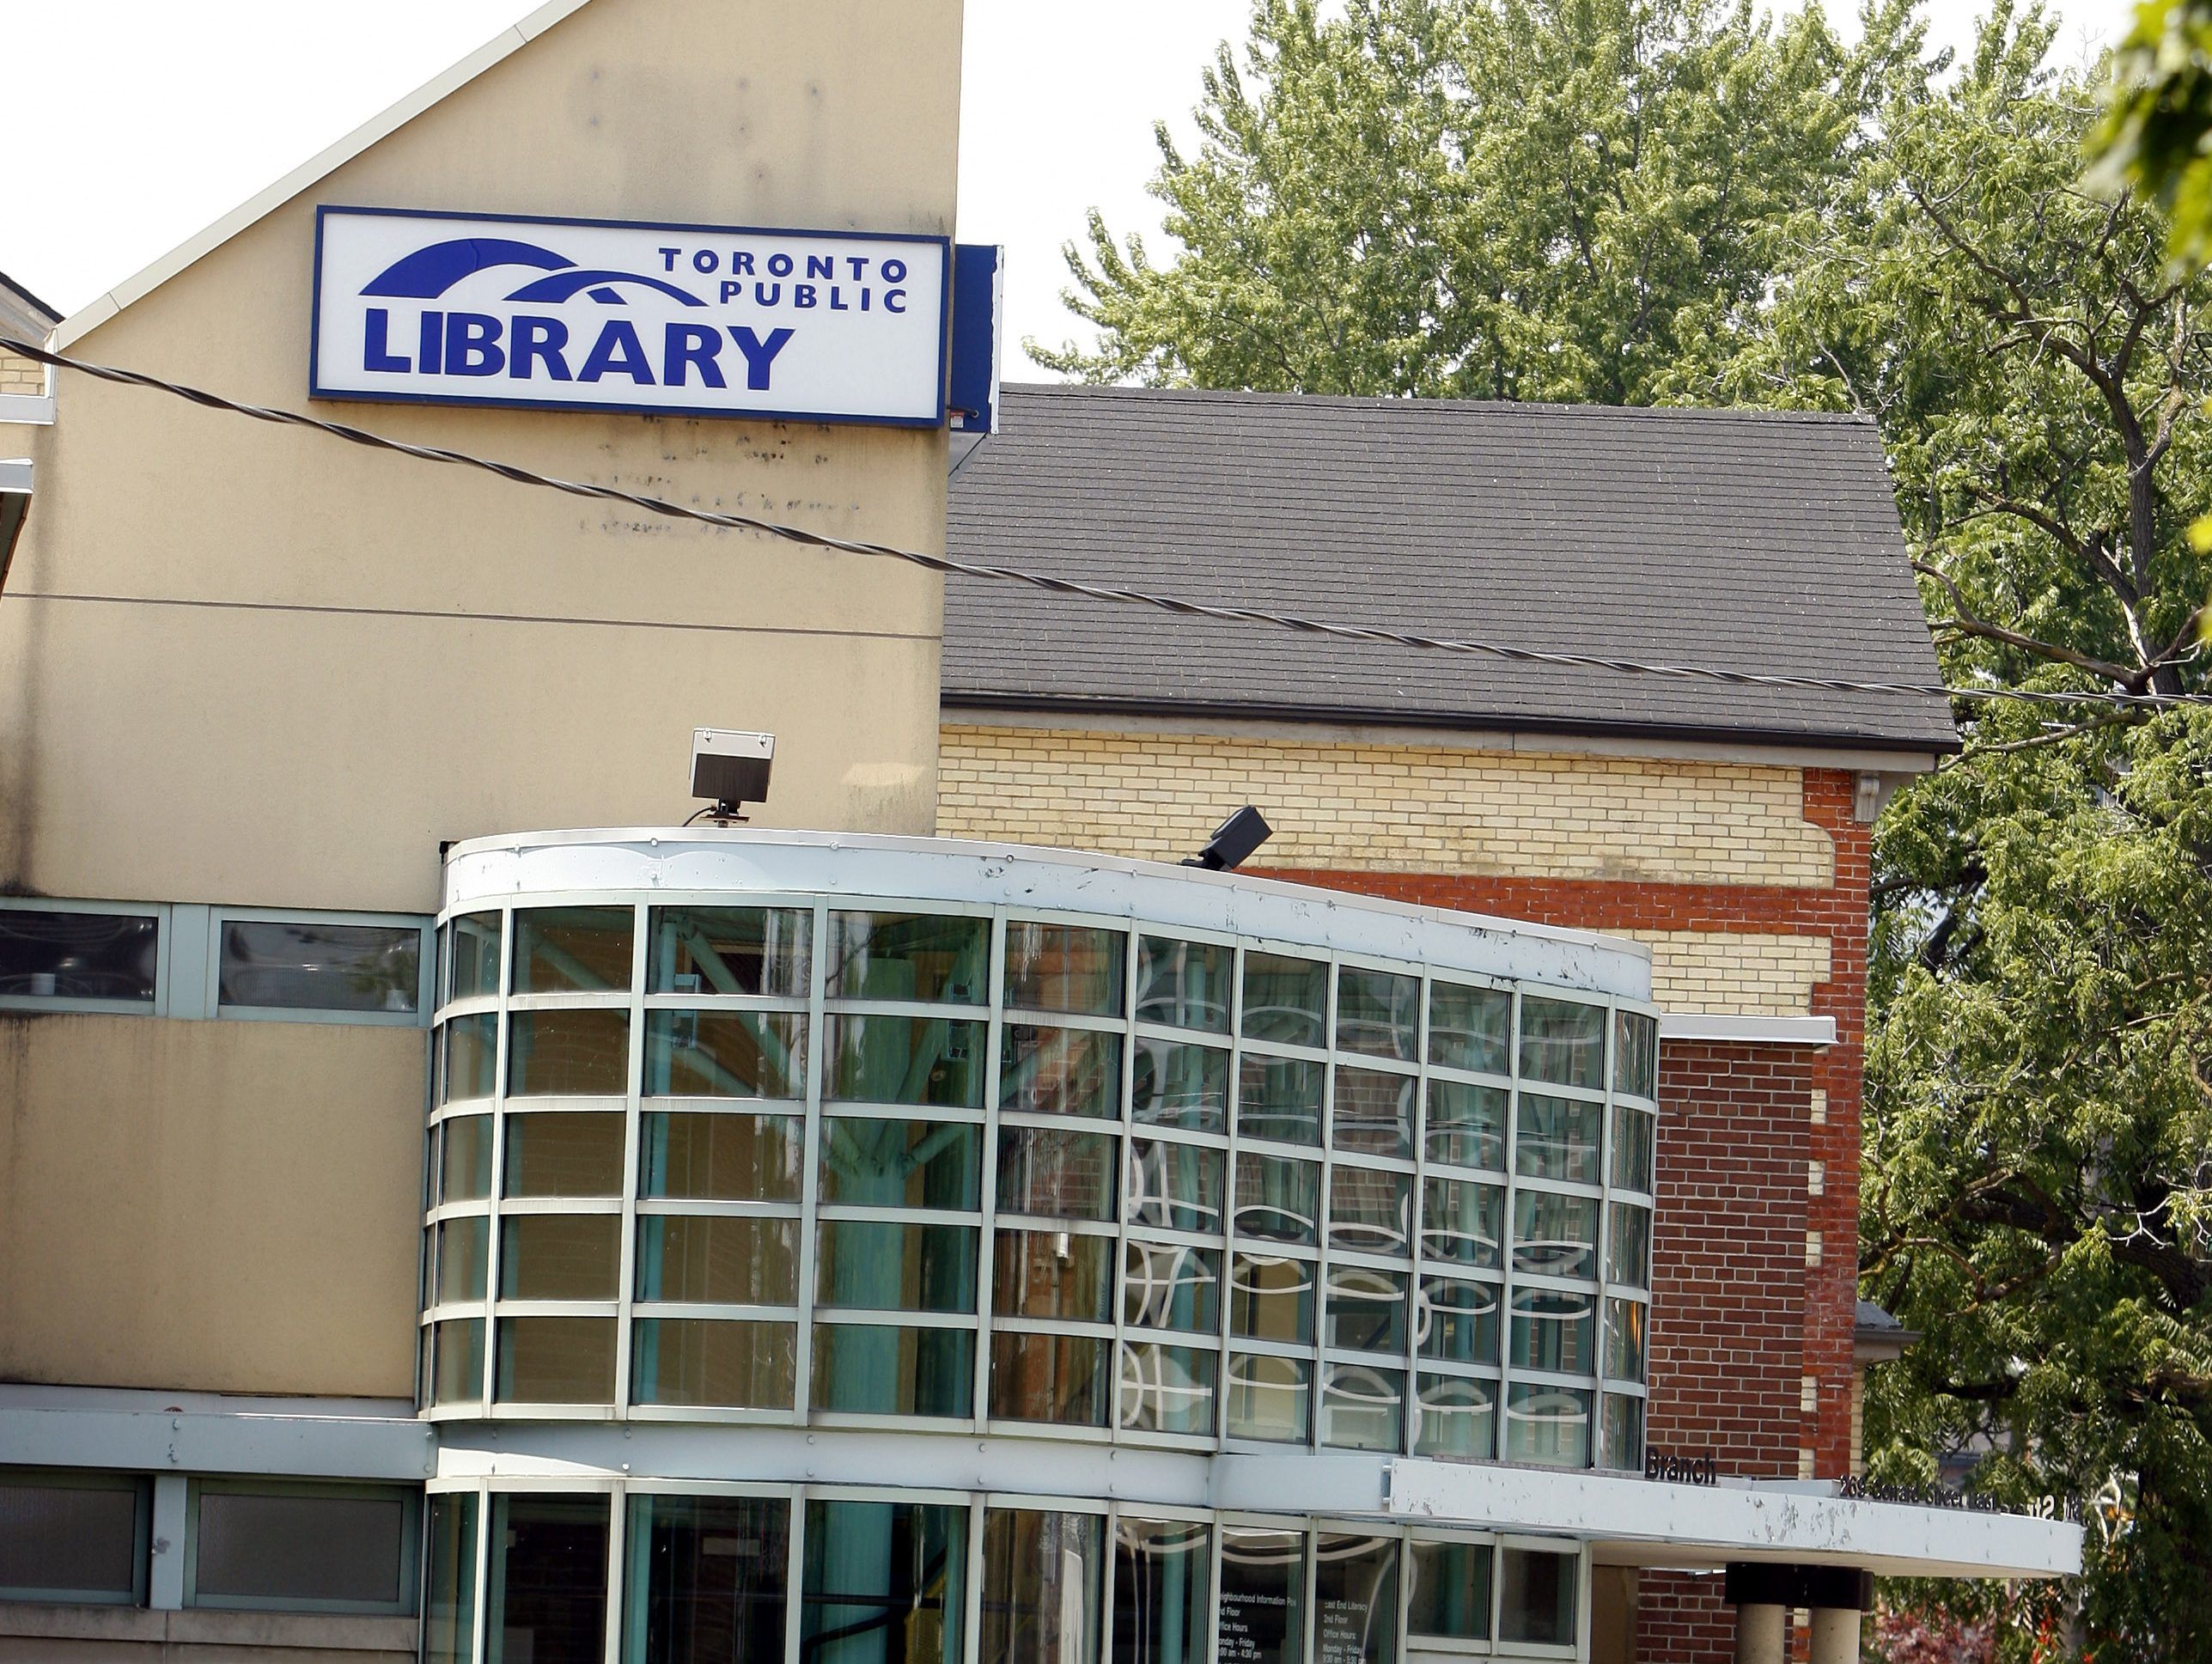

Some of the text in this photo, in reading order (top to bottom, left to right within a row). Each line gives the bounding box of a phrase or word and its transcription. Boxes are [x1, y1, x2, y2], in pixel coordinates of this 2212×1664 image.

[658, 247, 908, 283] TORONTO
[720, 279, 907, 313] PUBLIC
[364, 308, 796, 391] LIBRARY
[1644, 1446, 1716, 1484] Branch
[1840, 1474, 1866, 1498] 269
[1227, 1606, 1241, 1617] Floor
[1239, 1637, 1256, 1649] Friday
